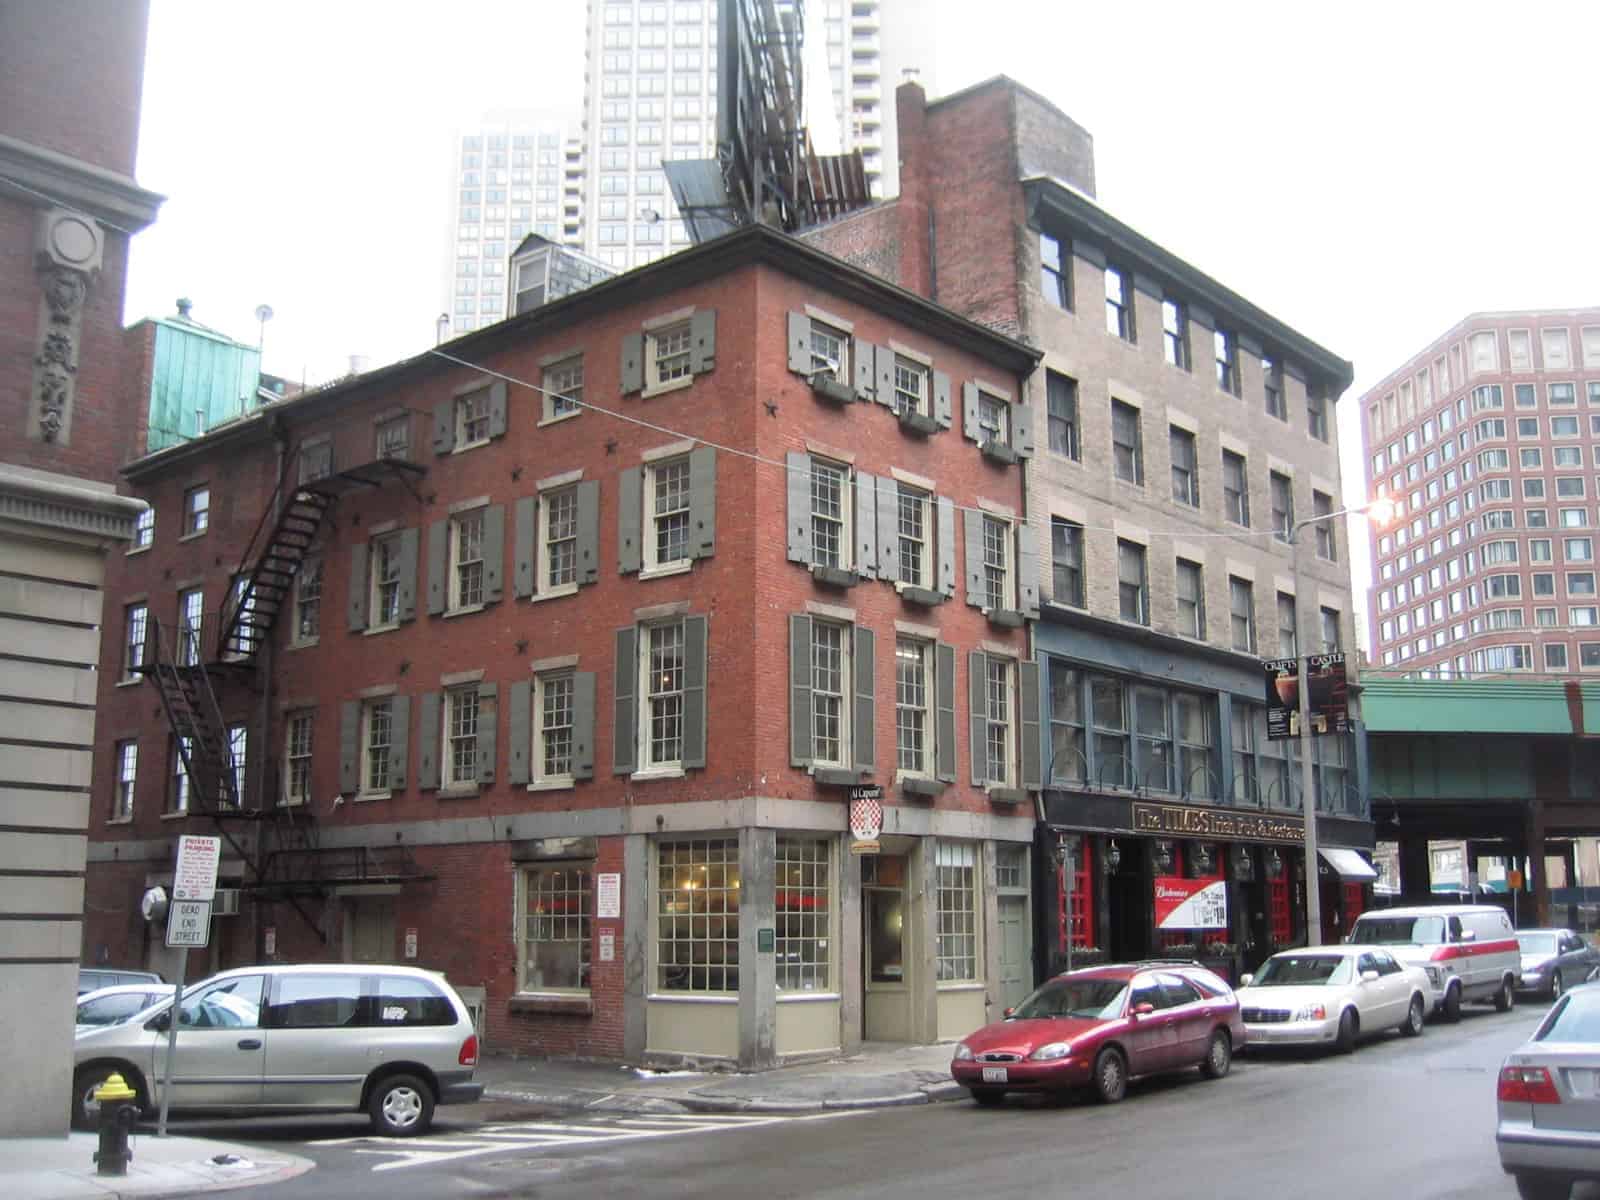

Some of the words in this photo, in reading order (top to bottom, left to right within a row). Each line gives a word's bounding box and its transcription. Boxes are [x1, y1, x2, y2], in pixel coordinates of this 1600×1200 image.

[1311, 653, 1344, 665] CASTLE
[1162, 807, 1209, 833] TIMES
[180, 903, 200, 914] DEAD
[181, 918, 197, 929] END
[174, 931, 201, 941] STREET
